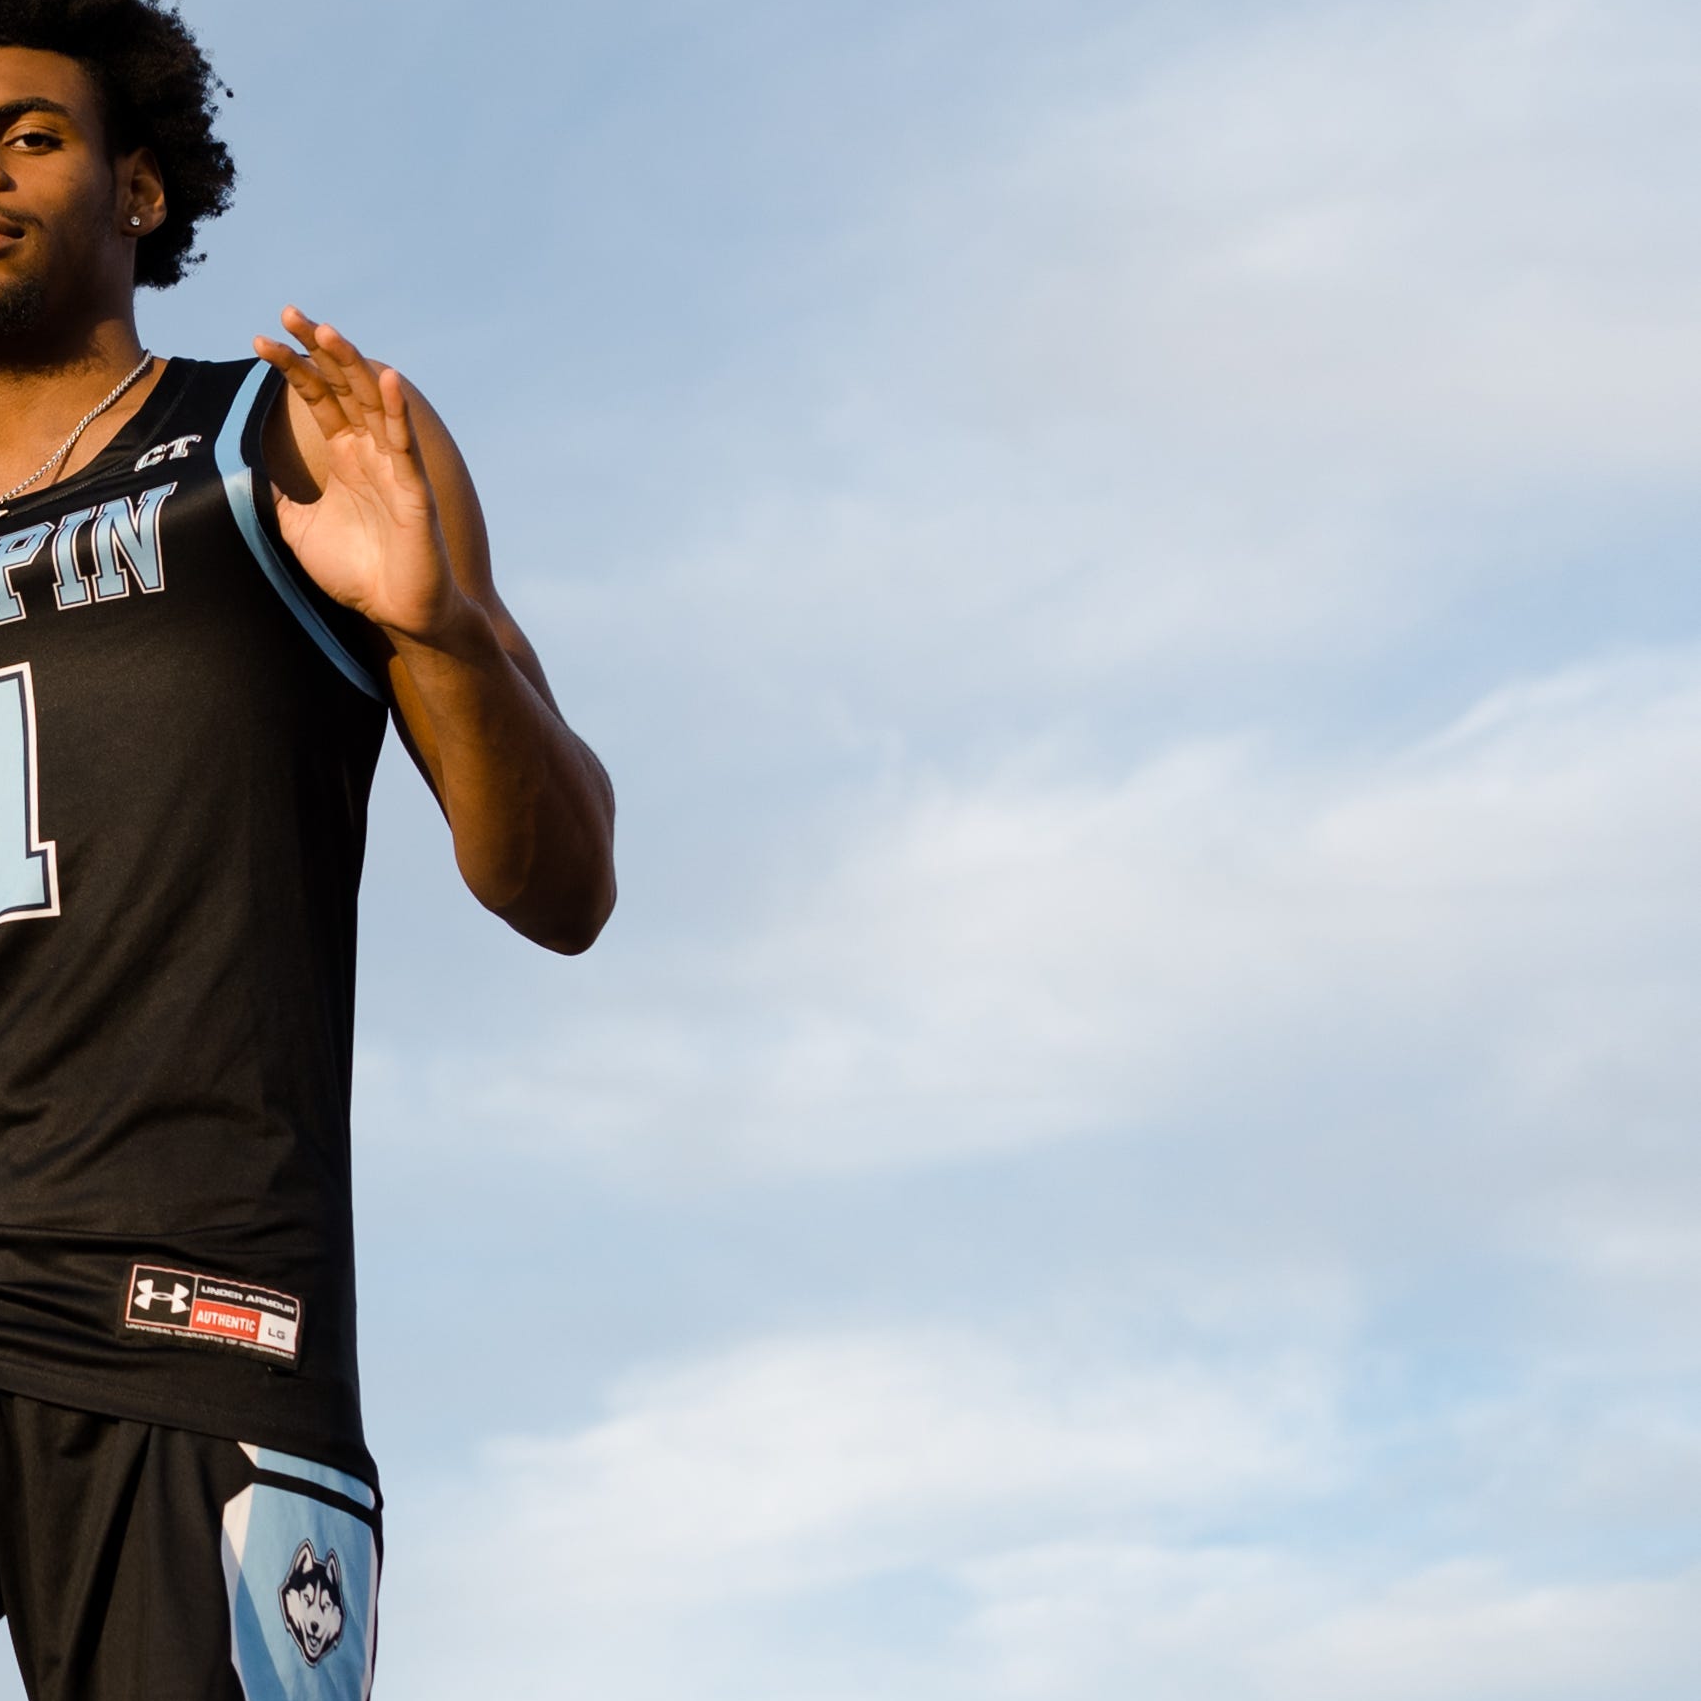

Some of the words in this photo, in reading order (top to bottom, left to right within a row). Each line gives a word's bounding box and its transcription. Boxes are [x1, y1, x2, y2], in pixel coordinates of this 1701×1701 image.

[134, 434, 202, 472] CT
[201, 1285, 243, 1301] UNDER
[245, 1294, 295, 1315] ARMOUR
[196, 1310, 256, 1333] AUTHENTIC
[267, 1327, 286, 1340] LG
